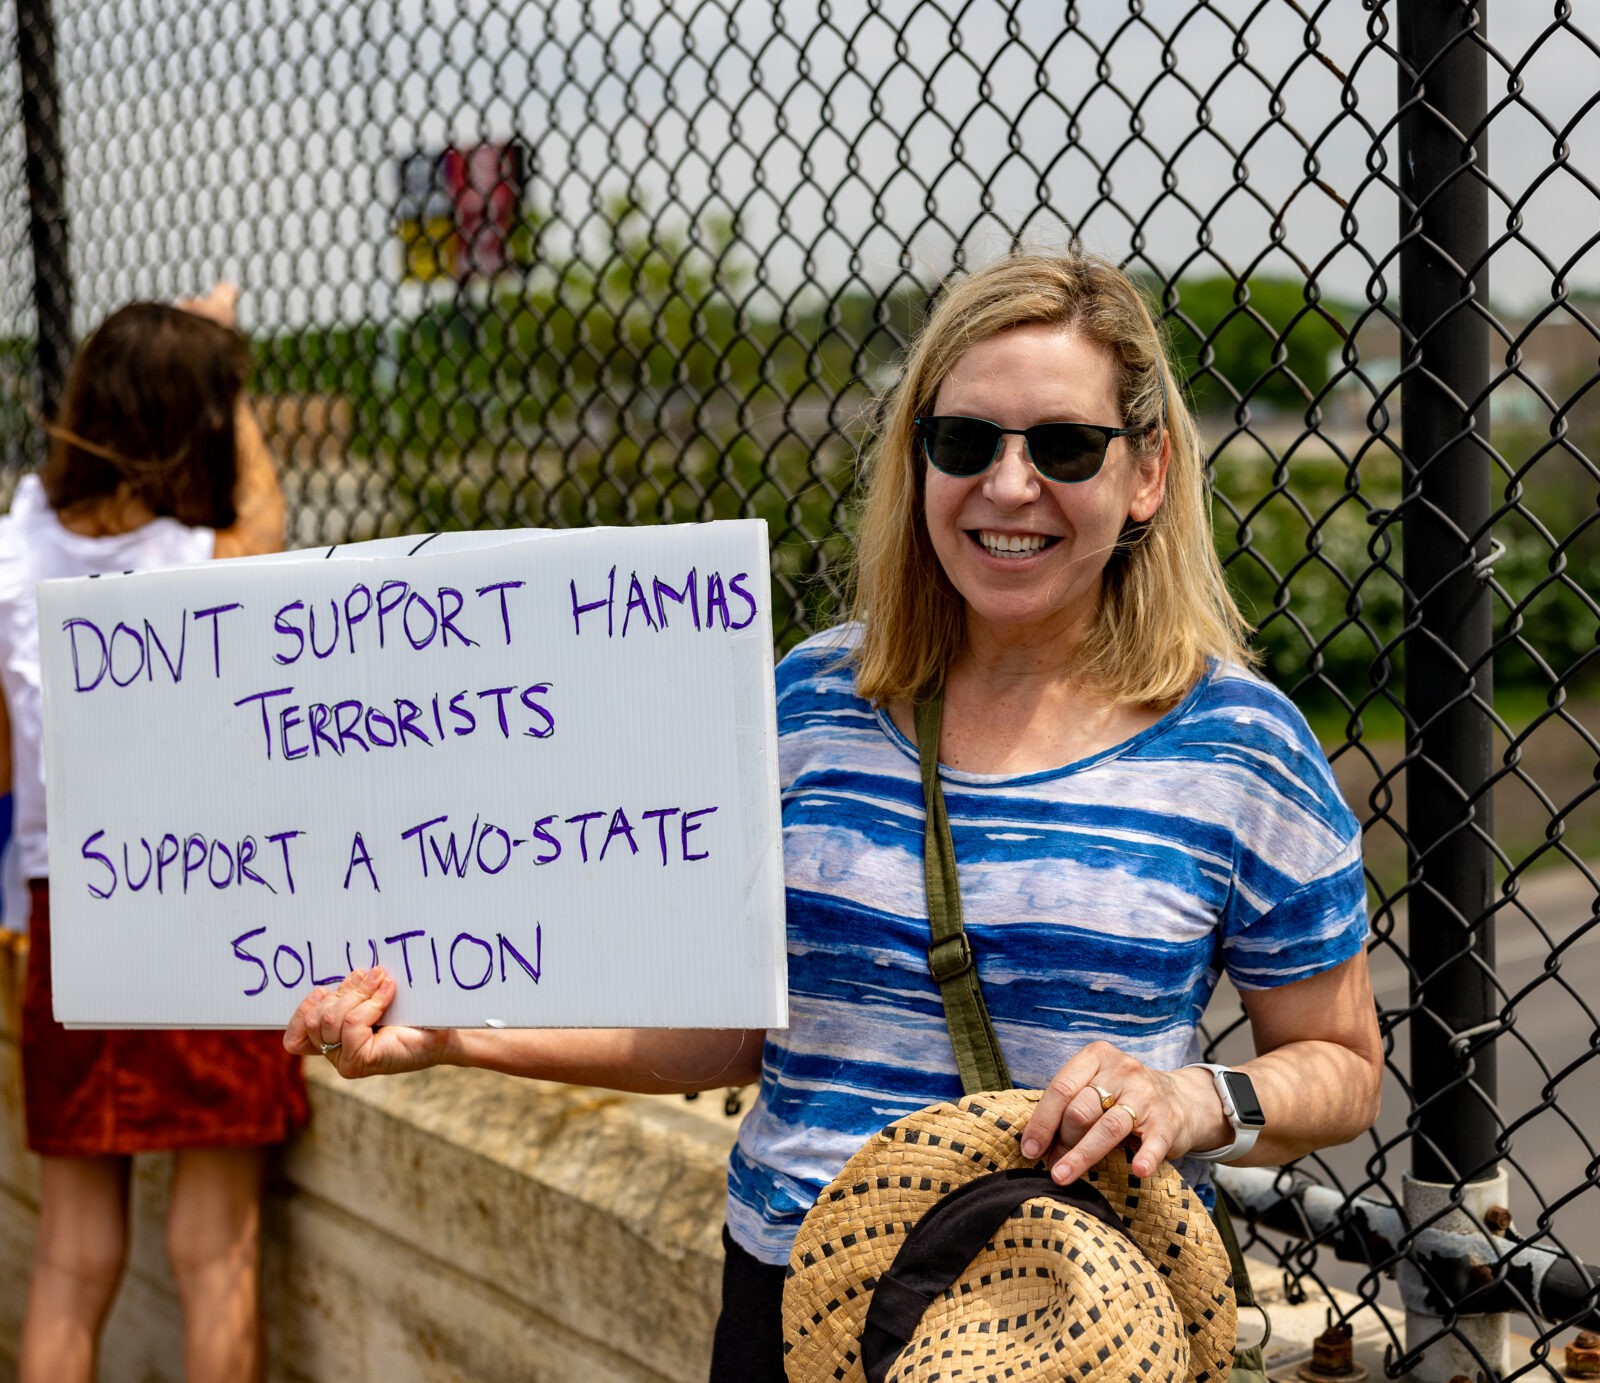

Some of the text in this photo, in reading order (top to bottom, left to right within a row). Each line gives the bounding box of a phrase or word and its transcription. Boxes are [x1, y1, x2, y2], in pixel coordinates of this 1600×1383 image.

[62, 565, 758, 693] DONT SUPPORT HAMAS
[234, 682, 555, 760] TERRORISTS
[81, 806, 719, 900] SUPPORT A TWO-STATE
[231, 921, 542, 997] SOLUTION
